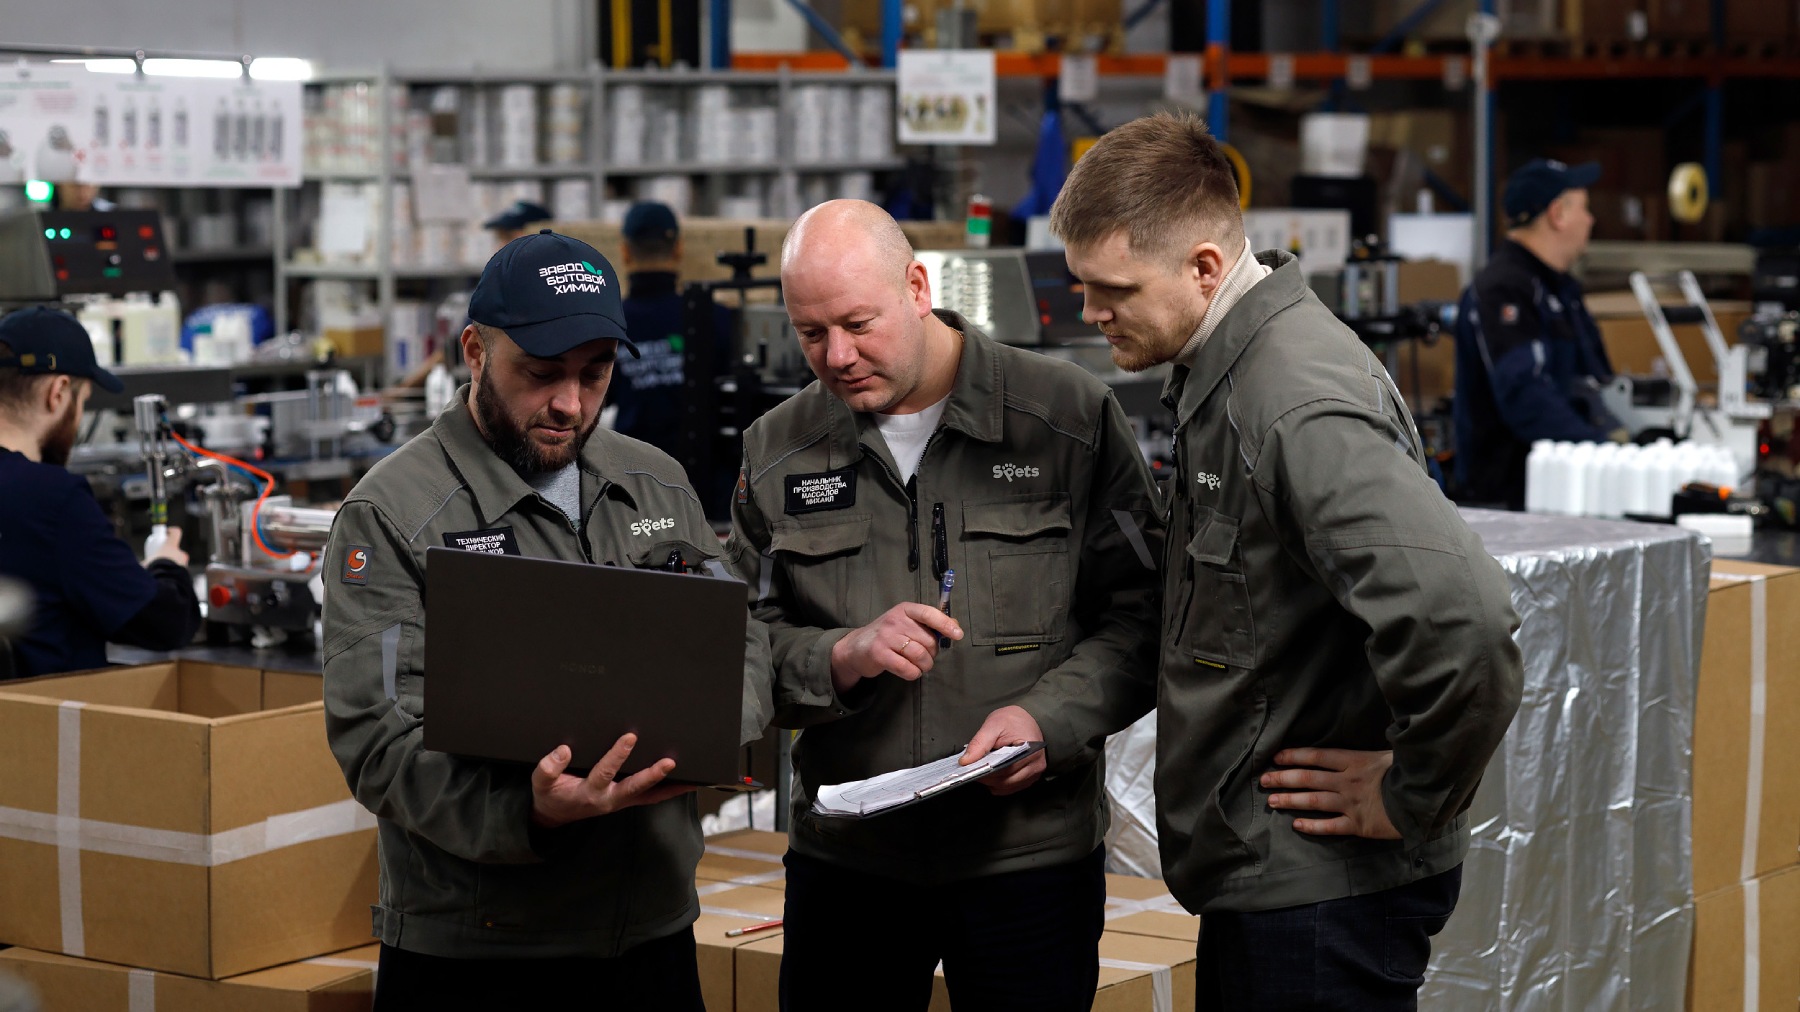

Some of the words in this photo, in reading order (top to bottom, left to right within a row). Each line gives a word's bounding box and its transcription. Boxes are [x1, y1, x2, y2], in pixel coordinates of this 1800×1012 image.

[539, 263, 585, 277] ЗАВОД
[546, 274, 606, 286] БЫТОВОЙ
[554, 284, 600, 295] ХИМИИ
[992, 463, 1040, 482] Spets
[801, 475, 842, 486] НАЧАЛЬНИК
[793, 481, 848, 494] ПРОИЗВОДСТВА
[801, 488, 839, 499] МАССАЛОВ
[805, 495, 835, 505] МИХАИЛ
[630, 517, 675, 537] Spets
[456, 533, 506, 546] ТЕХНИЧЕСКИЙ
[465, 541, 501, 551] ДИРЕКТОР
